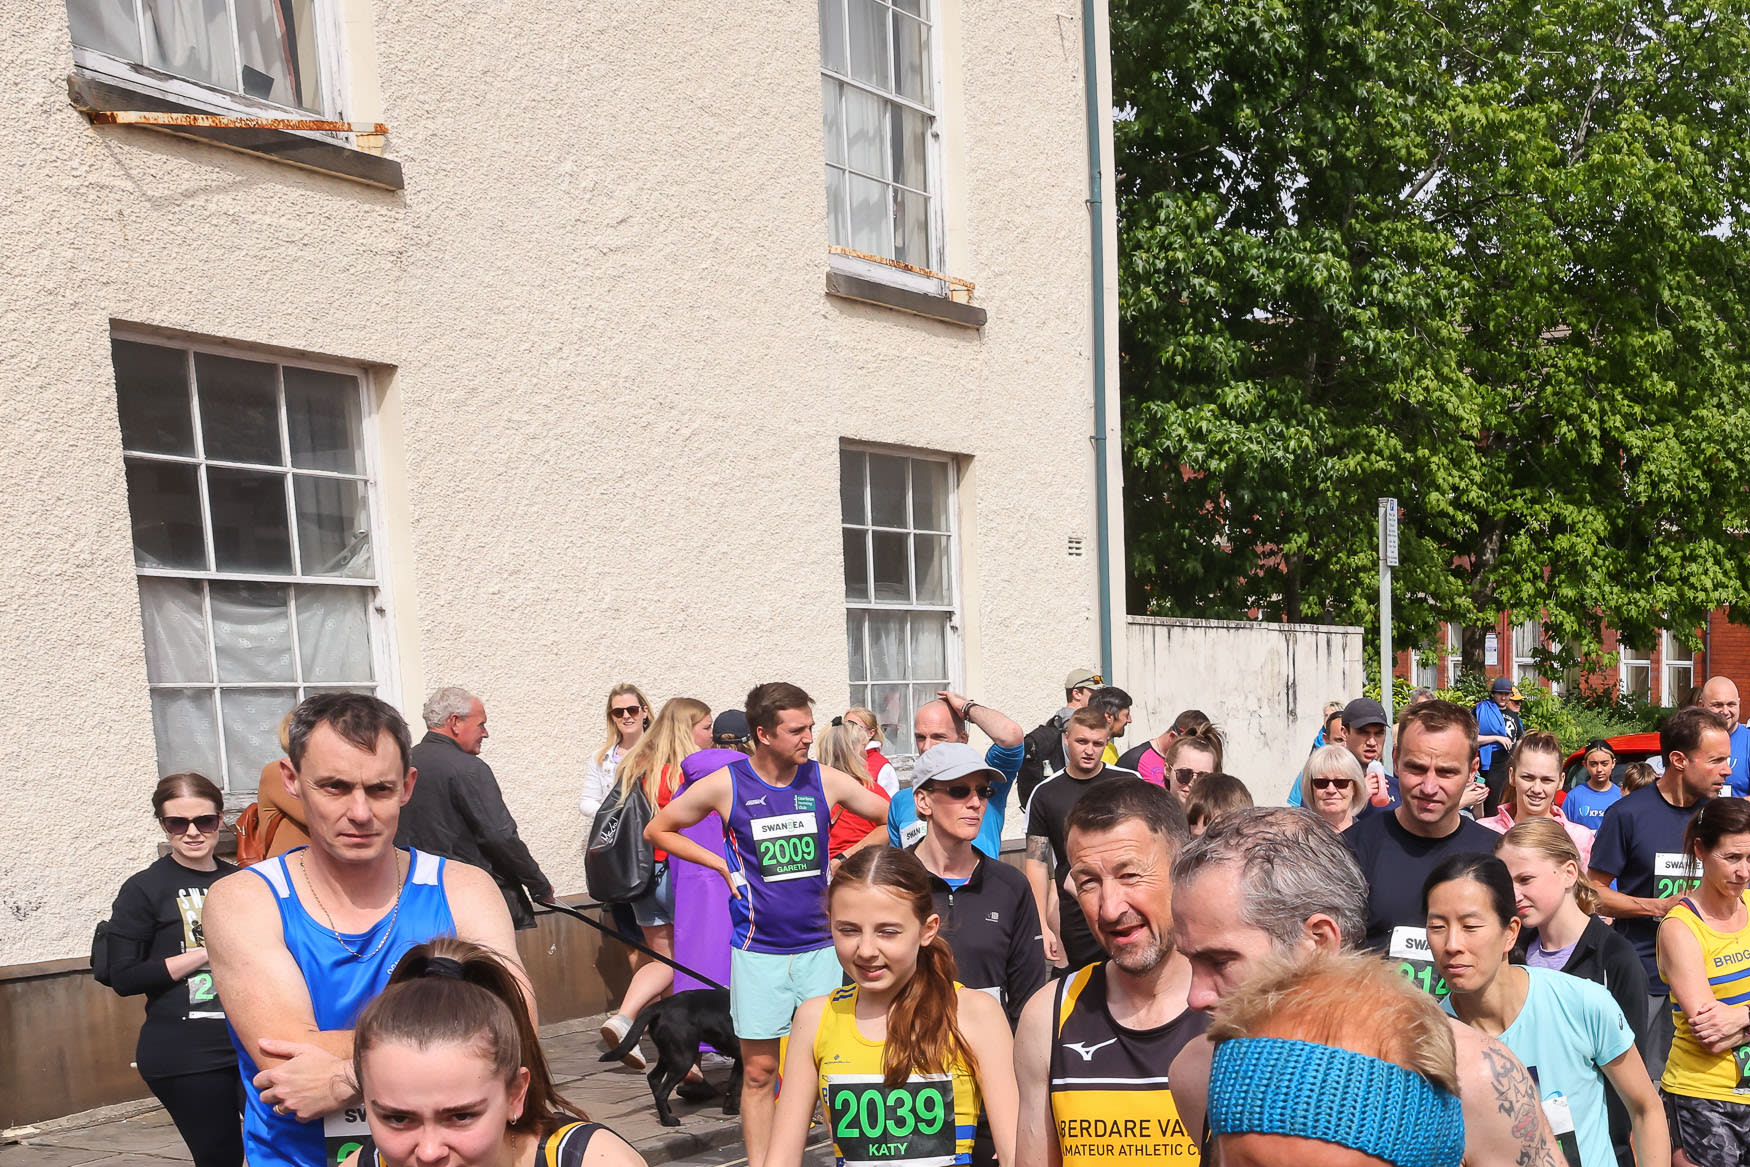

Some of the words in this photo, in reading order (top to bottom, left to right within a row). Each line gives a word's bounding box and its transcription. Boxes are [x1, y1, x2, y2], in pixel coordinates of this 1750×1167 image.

[760, 836, 815, 866] 2009
[776, 863, 808, 873] GARETH
[834, 1088, 945, 1138] 2039
[1058, 1119, 1152, 1138] BERDARE
[869, 1143, 908, 1156] KATY
[1118, 1143, 1183, 1157] ATHLETIC
